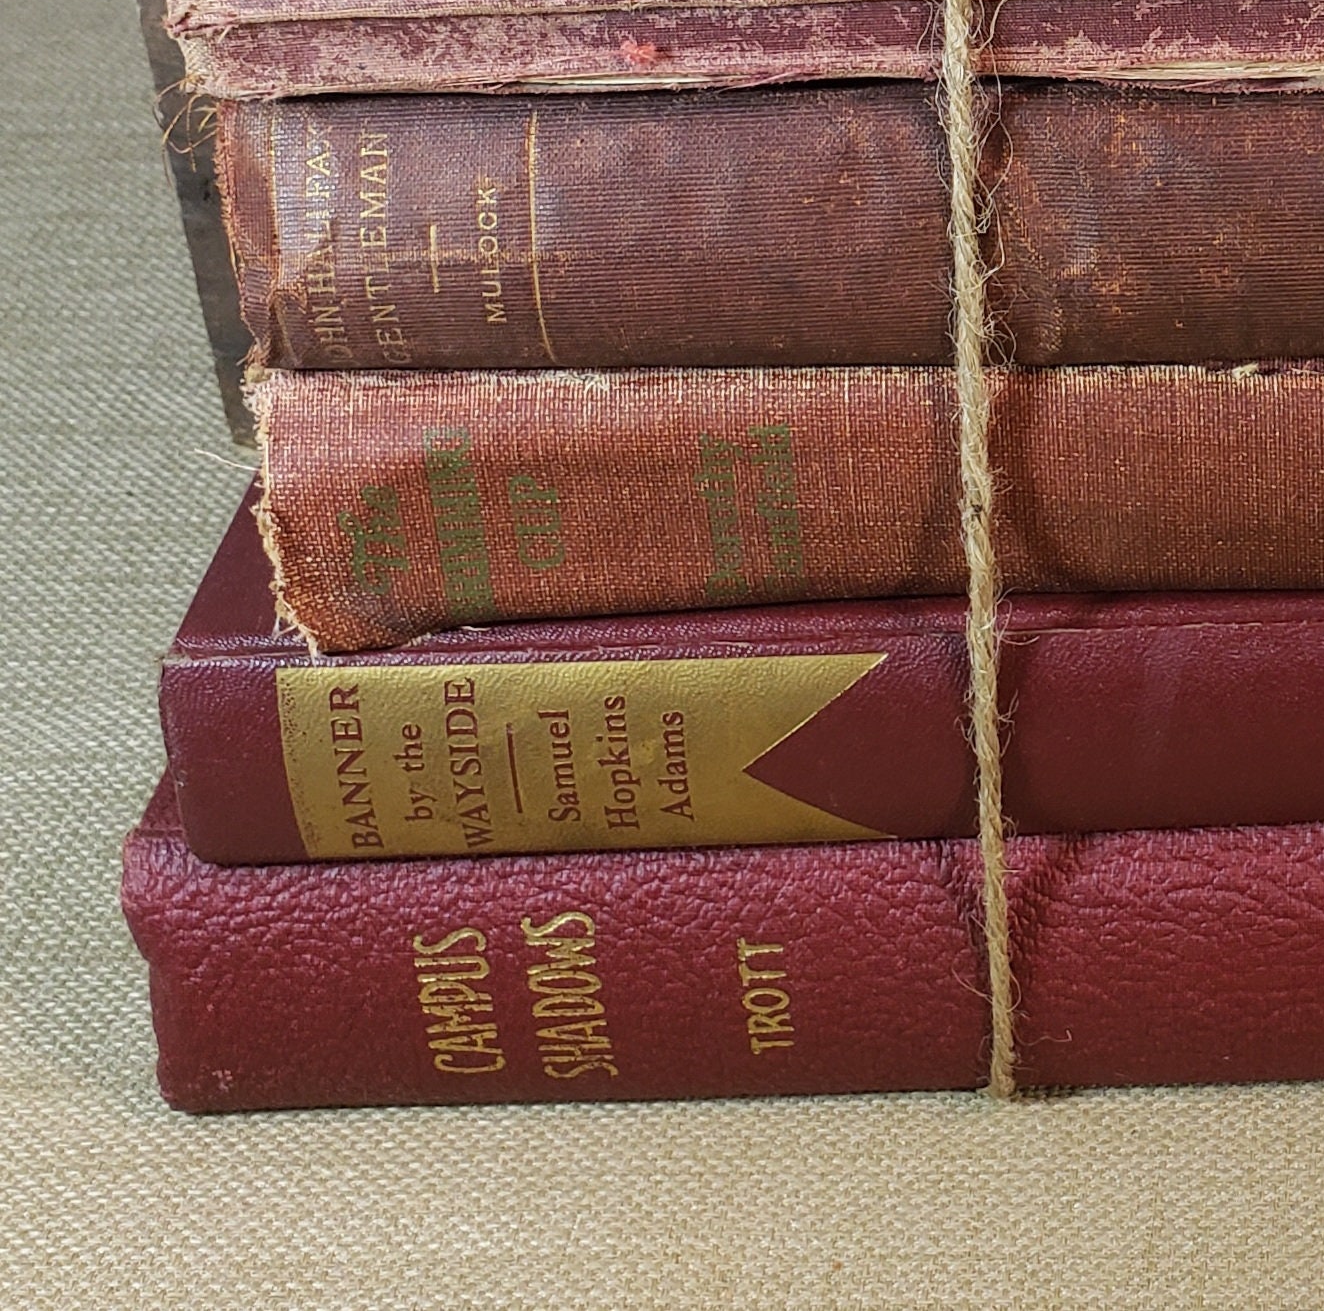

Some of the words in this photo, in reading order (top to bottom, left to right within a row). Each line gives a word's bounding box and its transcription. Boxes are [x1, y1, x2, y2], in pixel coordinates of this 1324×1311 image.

[360, 126, 412, 364] GENTLEMAN
[477, 182, 506, 323] MULOCK
[508, 474, 566, 570] CUP
[329, 683, 385, 850] BANNER
[393, 723, 424, 773] the
[404, 794, 438, 824] by
[444, 677, 495, 849] WAYSIDE
[537, 708, 581, 823] Samuel
[596, 695, 640, 832] Hopkins
[657, 711, 695, 822] Adams
[412, 927, 506, 1074] CAMPUS
[521, 911, 619, 1079] SHADOWS
[736, 937, 795, 1055] TROTT
